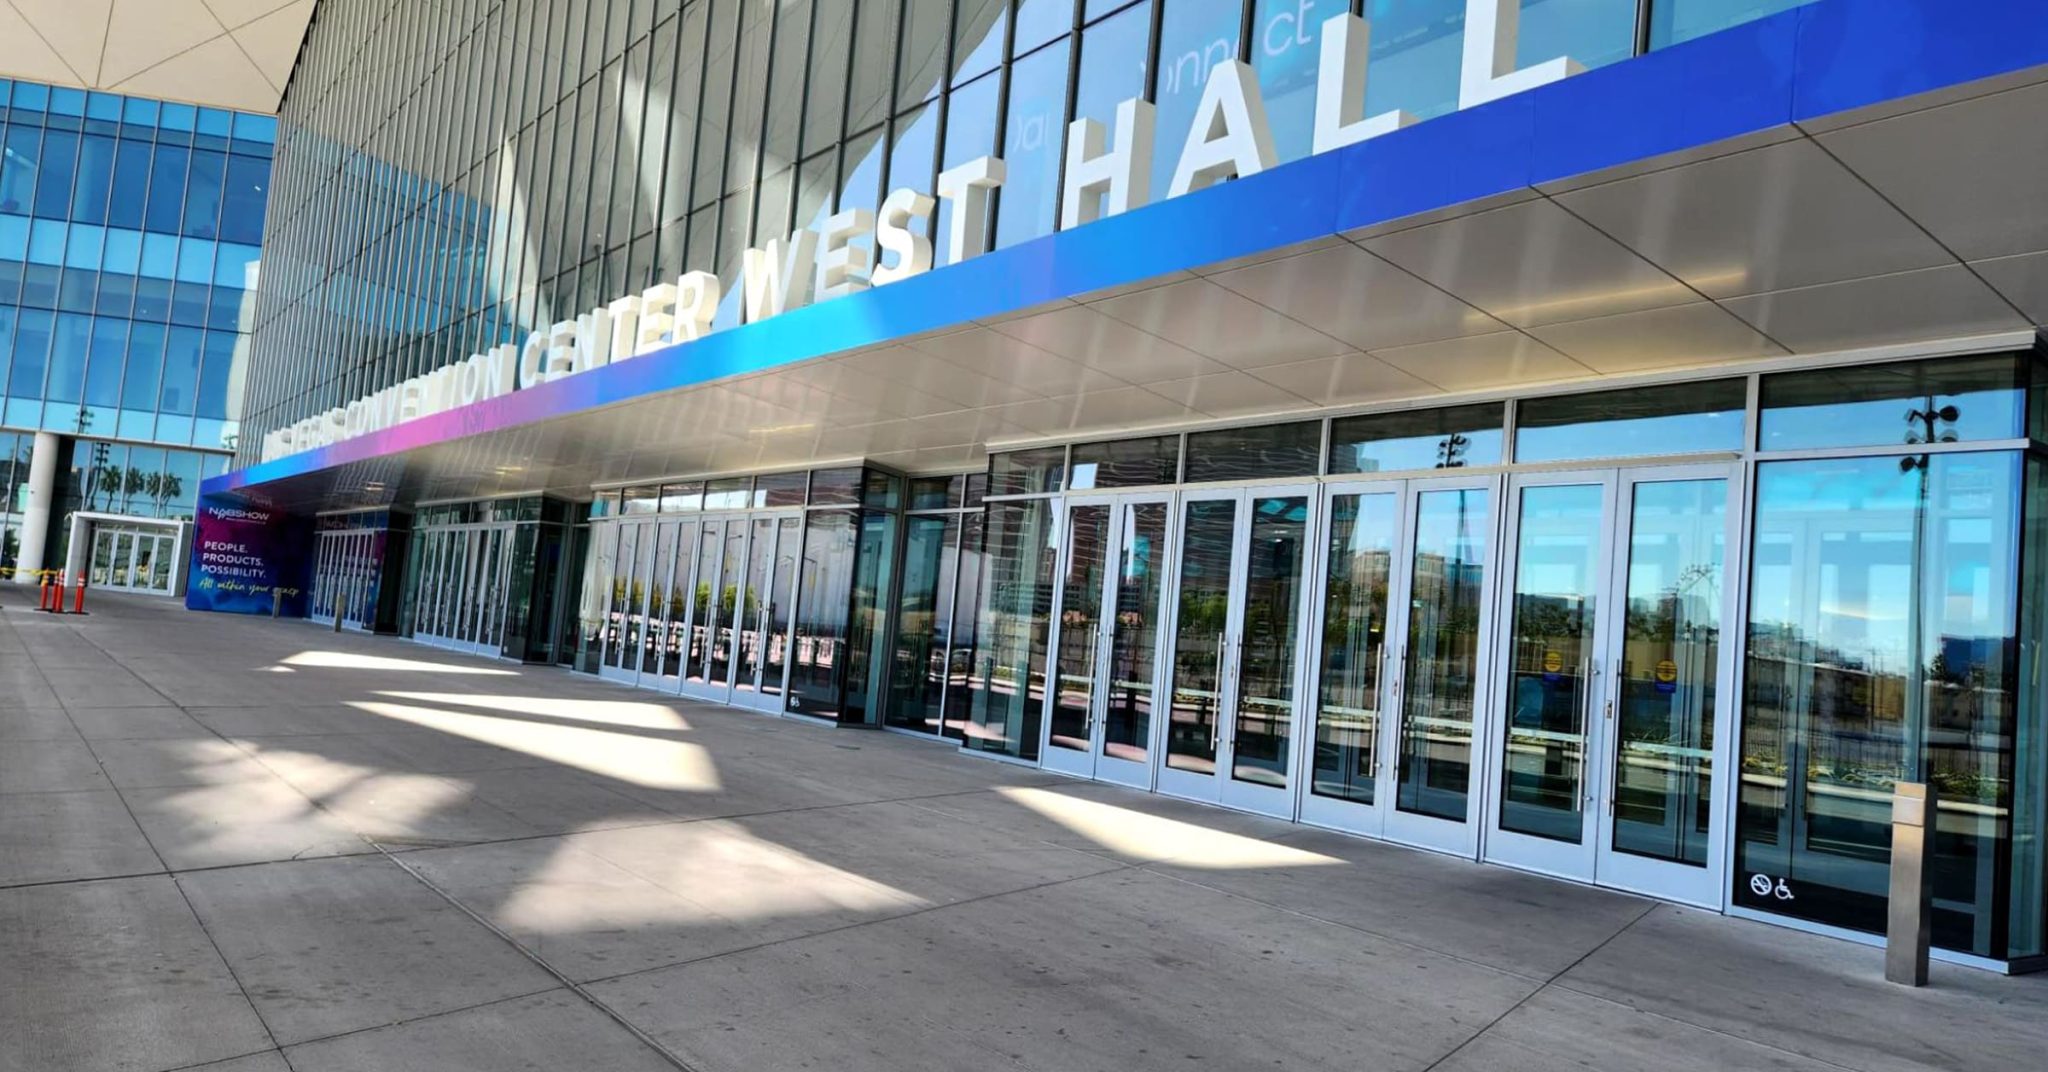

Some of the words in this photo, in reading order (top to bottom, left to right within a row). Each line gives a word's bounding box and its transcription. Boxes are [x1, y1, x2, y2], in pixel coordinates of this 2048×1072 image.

[519, 270, 721, 394] CENTER
[743, 155, 1006, 325] WEST
[1060, 0, 1588, 231] HALL
[203, 540, 248, 553] PEOPLE.
[202, 552, 264, 566] PRODUCTS.
[200, 564, 266, 578] POSSIBILITY.
[199, 576, 214, 589] All
